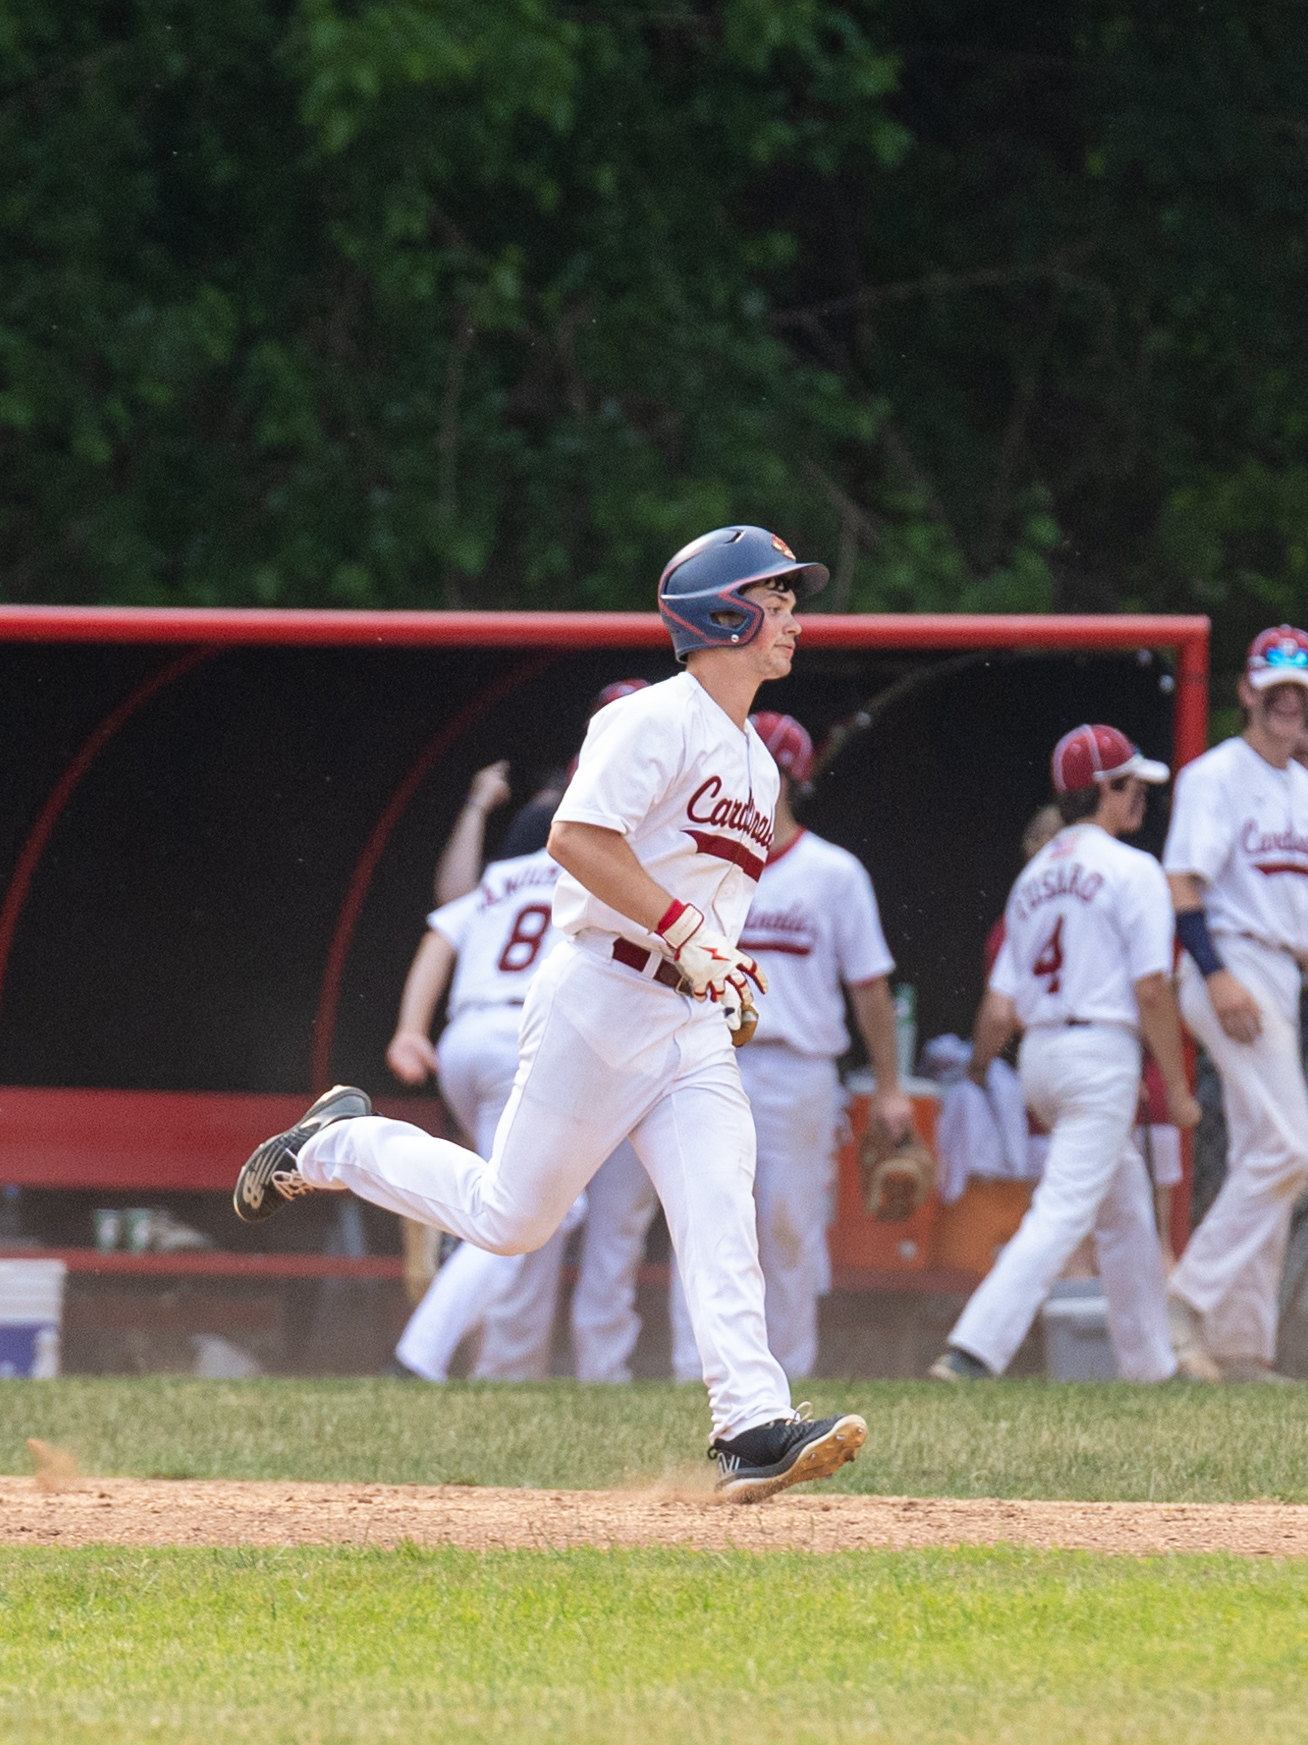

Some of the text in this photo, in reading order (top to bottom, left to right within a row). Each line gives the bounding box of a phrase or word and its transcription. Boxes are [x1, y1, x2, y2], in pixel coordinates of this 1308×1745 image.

[686, 775, 774, 851] Cardinal
[498, 903, 553, 972] 8
[1032, 912, 1064, 993] 4
